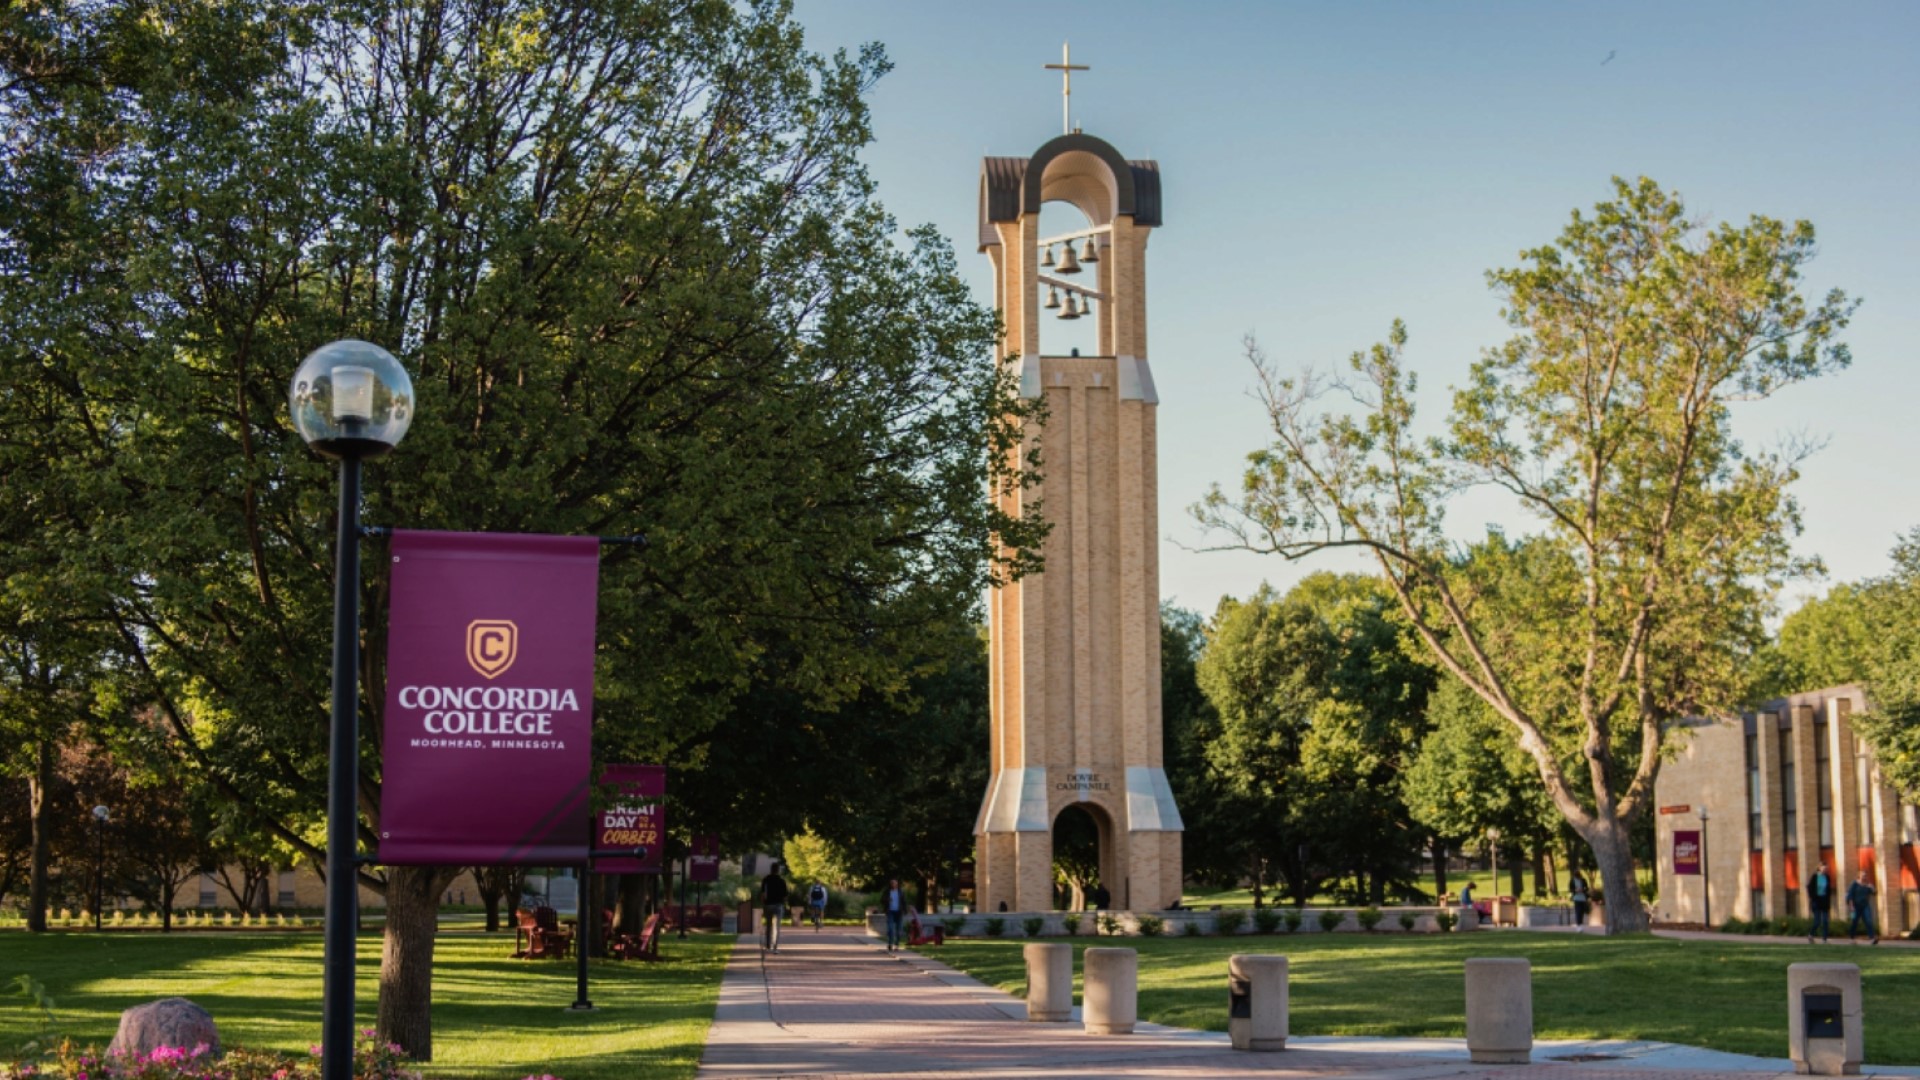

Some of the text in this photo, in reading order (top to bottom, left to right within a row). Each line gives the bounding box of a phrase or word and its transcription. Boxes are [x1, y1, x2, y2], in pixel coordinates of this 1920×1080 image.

[480, 631, 504, 661] C
[398, 685, 580, 711] CONCORDIA
[423, 710, 553, 735] COLLEGE
[410, 738, 565, 750] MOORHEAD, MINNESOTA
[604, 816, 637, 828] DAY
[602, 829, 657, 845] COBBER
